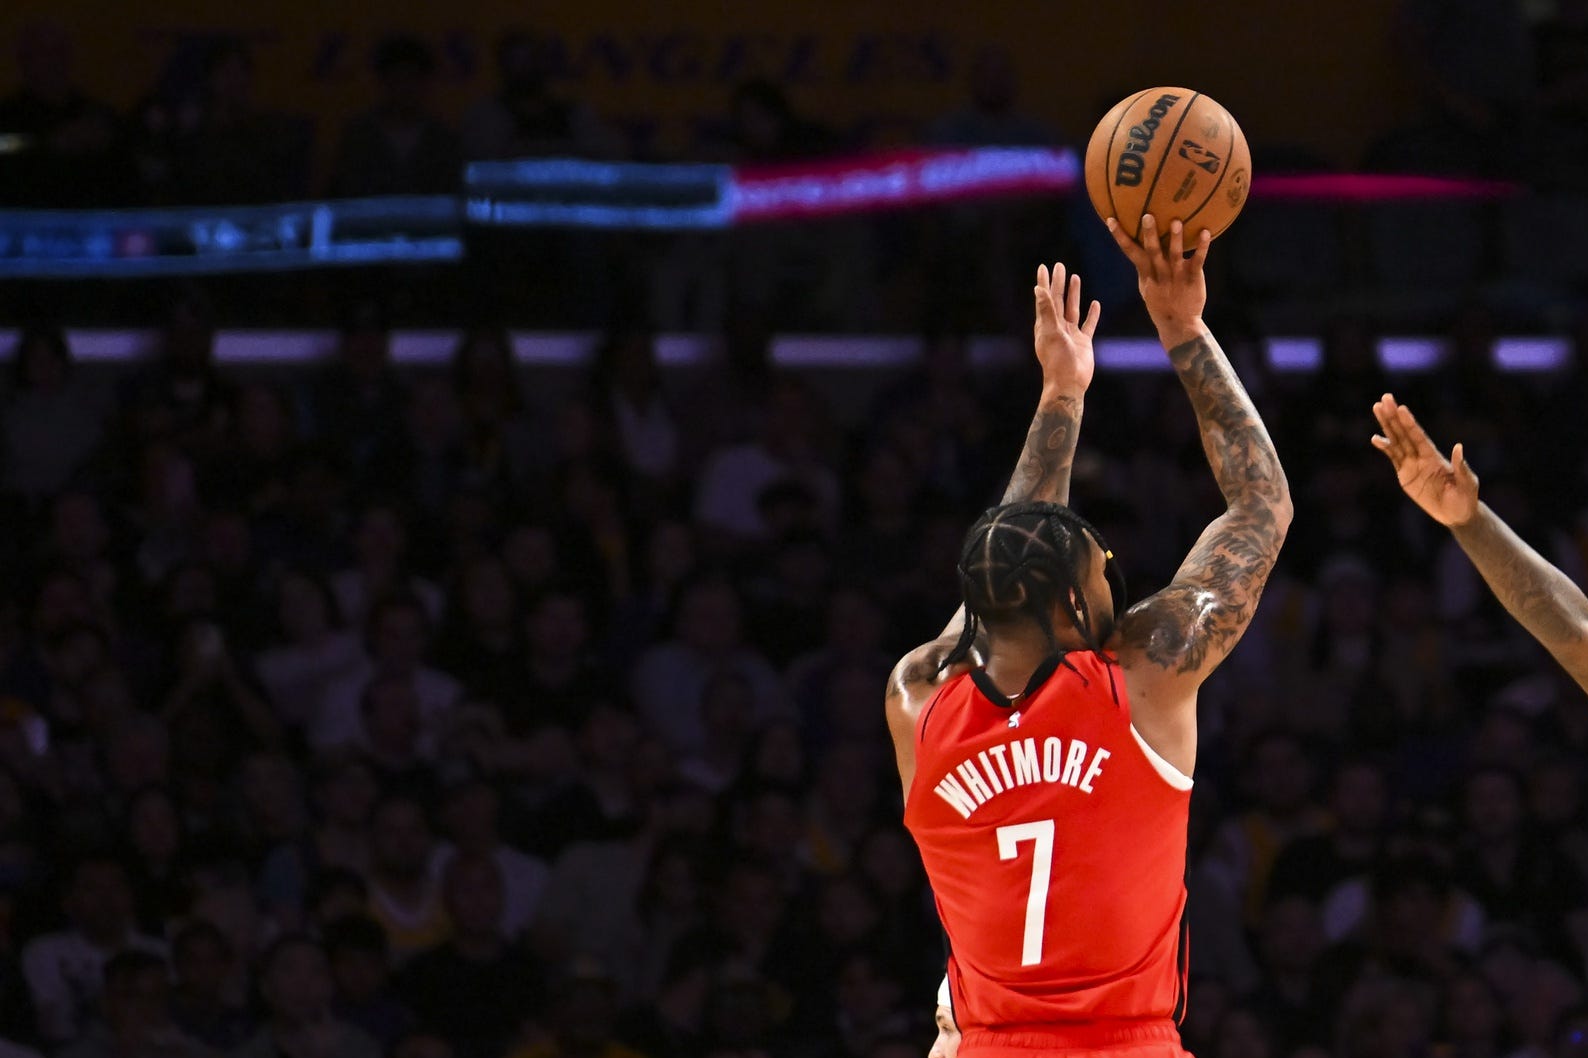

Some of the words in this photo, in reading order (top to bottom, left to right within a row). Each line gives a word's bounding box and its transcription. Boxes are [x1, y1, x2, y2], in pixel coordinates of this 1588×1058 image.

[1115, 94, 1180, 187] Wilson
[933, 736, 1112, 820] WHITMORE
[996, 818, 1056, 967] 7
